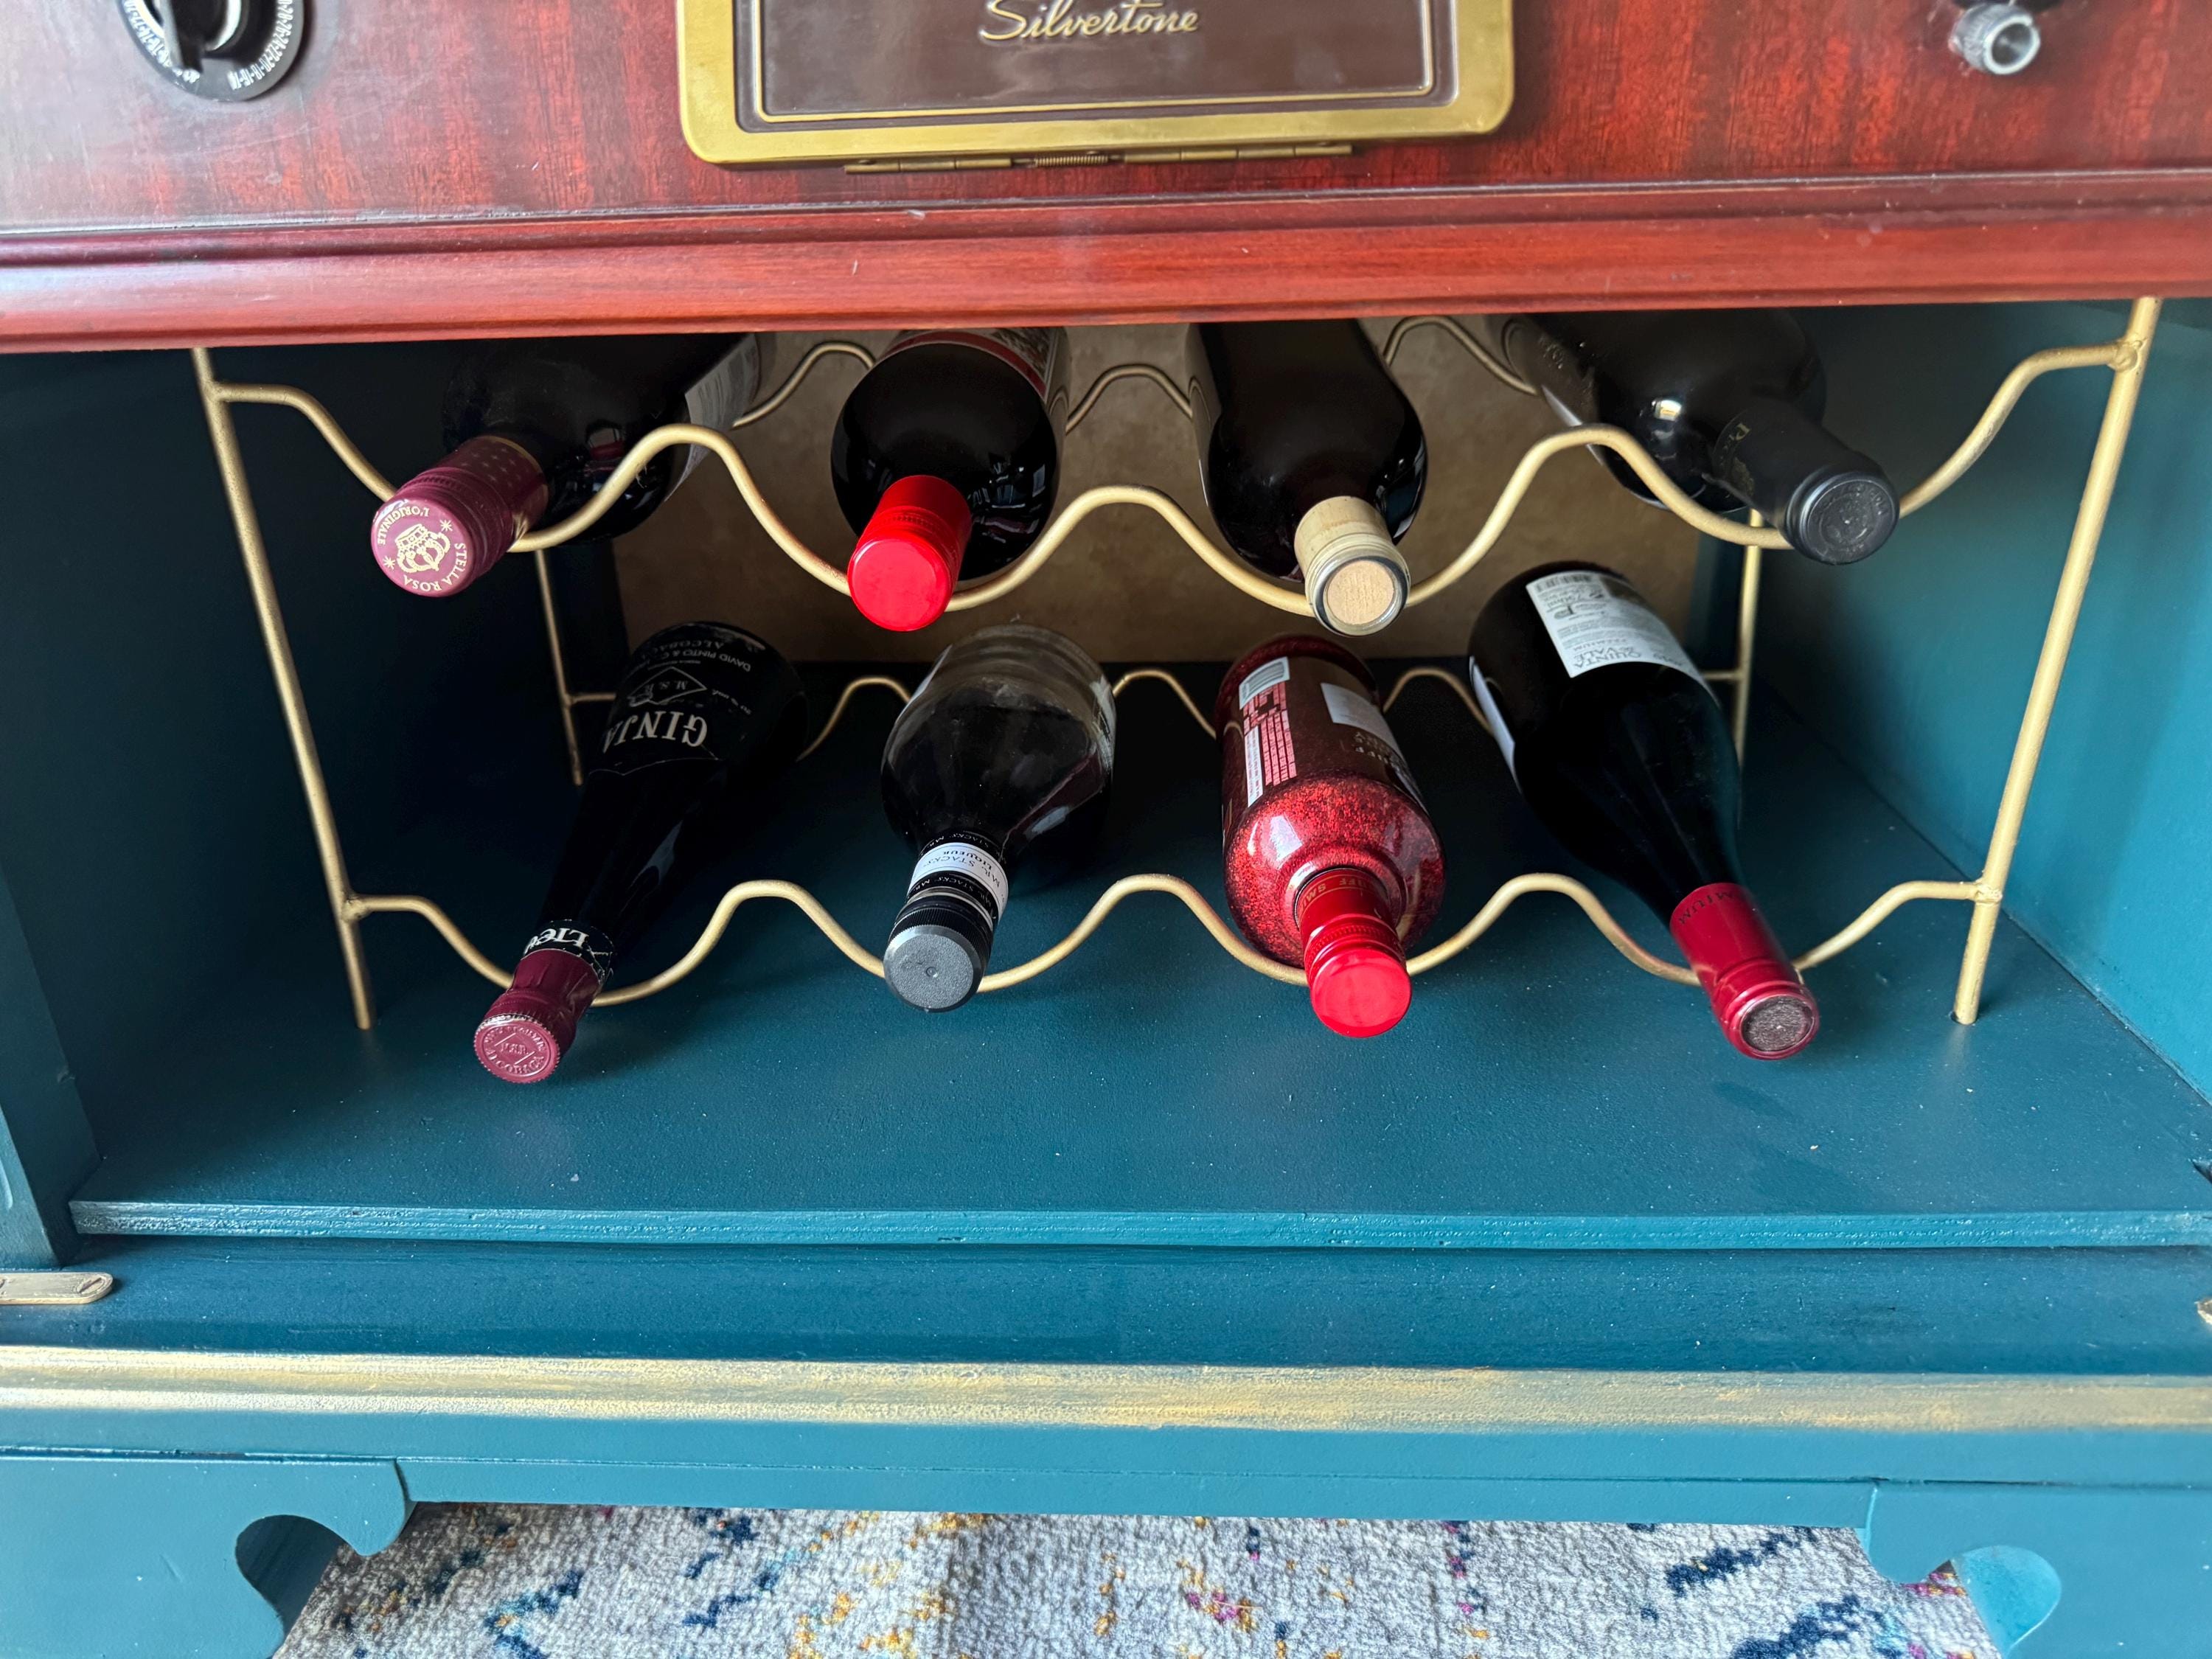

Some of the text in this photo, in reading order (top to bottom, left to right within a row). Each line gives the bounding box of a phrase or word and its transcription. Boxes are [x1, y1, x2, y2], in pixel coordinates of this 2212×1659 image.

[979, 0, 1198, 40] Silvertone
[377, 506, 431, 546] L'ORIGINALE
[403, 542, 467, 592] STELLA ROSA
[1575, 652, 1642, 669] QUINTA
[602, 710, 708, 754] GINJA
[944, 849, 992, 870] LIQUEUR
